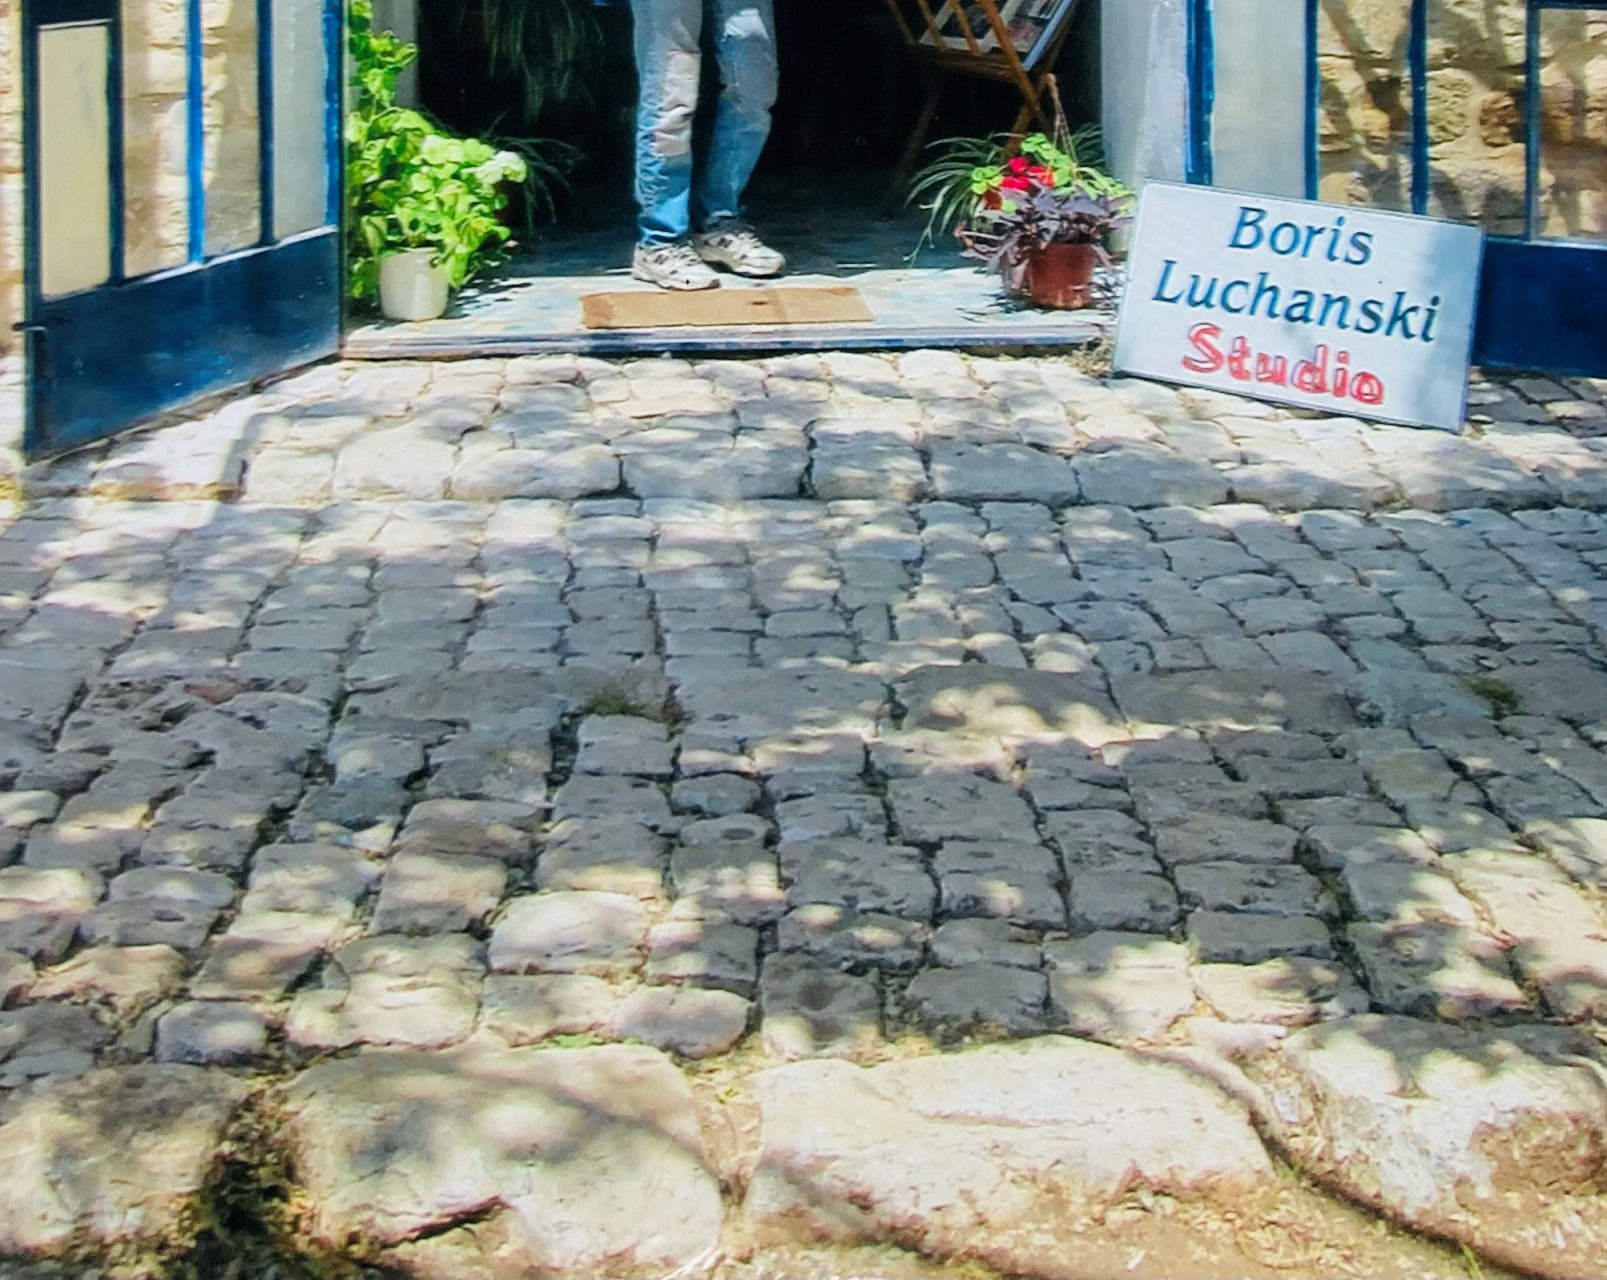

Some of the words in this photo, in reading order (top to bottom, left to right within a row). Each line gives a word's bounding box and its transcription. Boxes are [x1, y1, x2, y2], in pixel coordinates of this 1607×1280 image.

[1227, 206, 1374, 266] Boris
[1152, 260, 1441, 342] Luchanski
[1182, 322, 1385, 405] Studio
